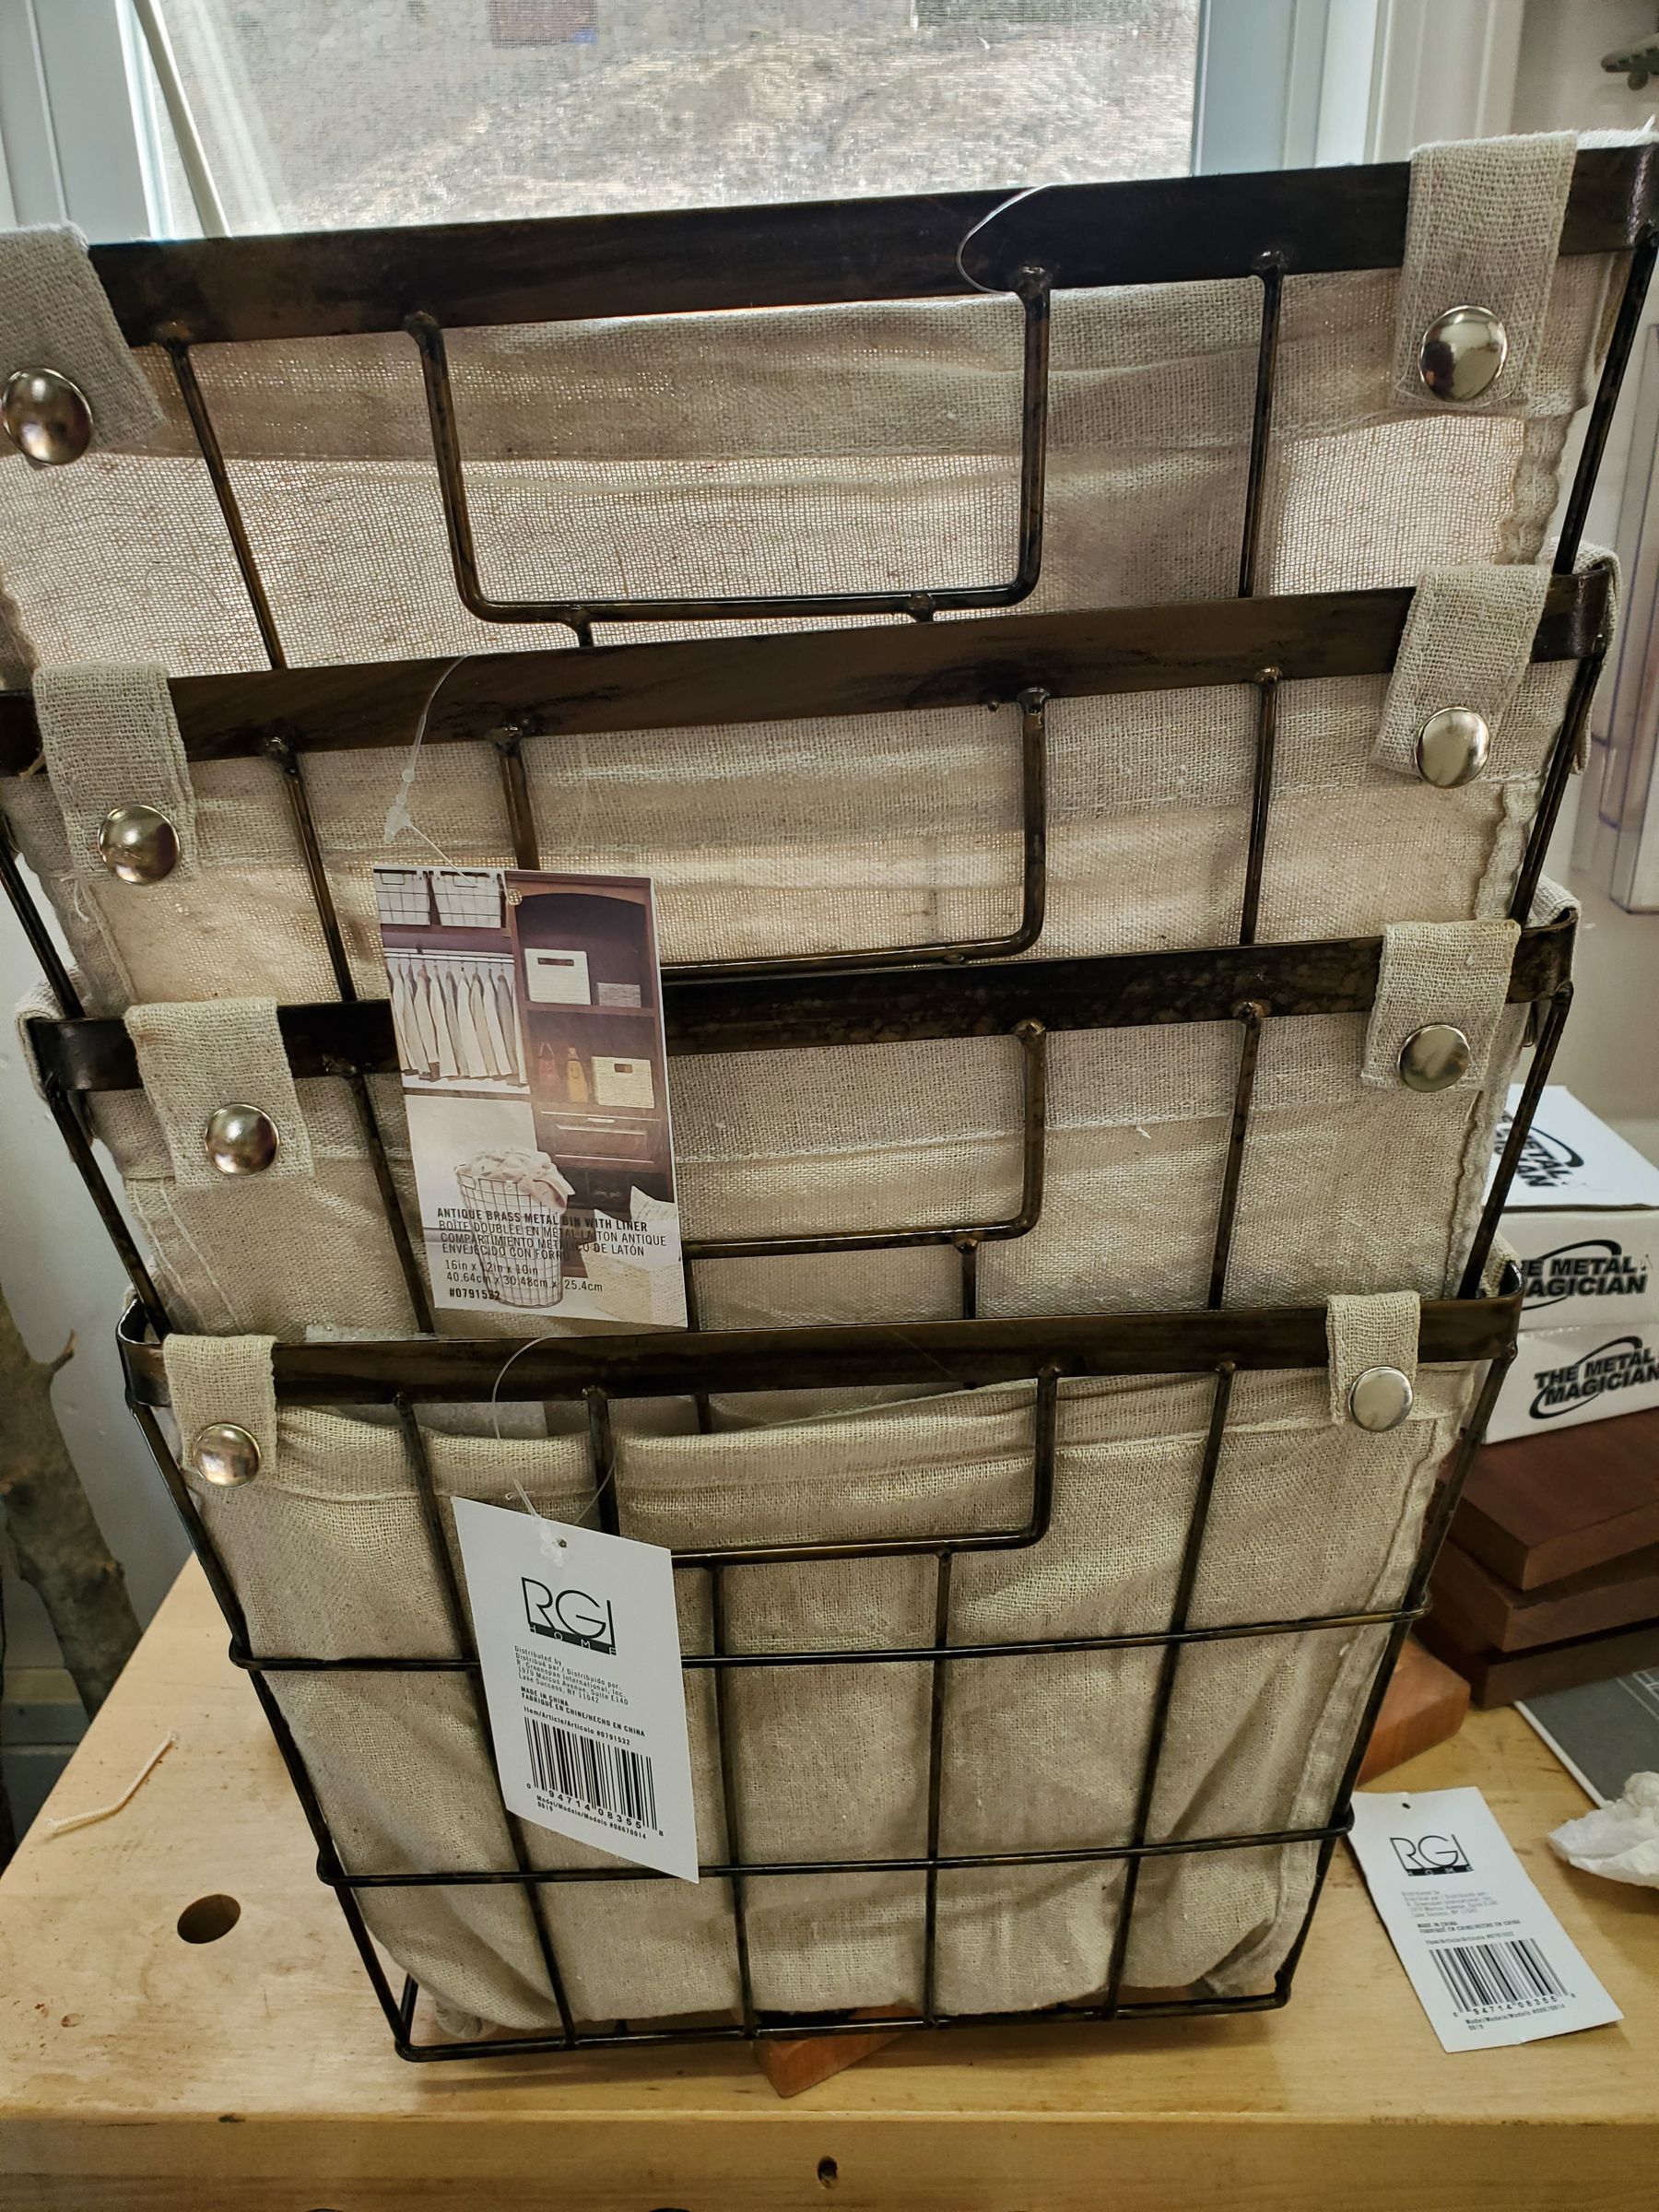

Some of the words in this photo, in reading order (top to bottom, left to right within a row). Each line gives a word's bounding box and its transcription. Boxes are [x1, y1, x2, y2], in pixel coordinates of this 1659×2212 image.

[437, 1207, 482, 1220] ANTIQUE
[488, 1211, 521, 1222] BRASS
[524, 1213, 559, 1225] METAL
[563, 1216, 581, 1227] BIN
[584, 1217, 611, 1230] WITH
[617, 1220, 648, 1232] LINER
[439, 1219, 469, 1231] BOÎTE
[474, 1222, 523, 1235] DOUBLÉE
[526, 1227, 539, 1236] EN
[621, 1233, 667, 1246] ANTIQUE
[441, 1232, 535, 1248] COMPARTIMIENTO
[594, 1242, 607, 1253] DE
[612, 1242, 644, 1256] LATÓN
[442, 1243, 506, 1256] ENVEJECIDO
[511, 1248, 531, 1258] CON
[535, 1250, 570, 1261] FORRO
[446, 1260, 468, 1270] 16in
[471, 1263, 477, 1271] x
[516, 1265, 538, 1276] 10in
[1549, 1255, 1638, 1277] METAL
[446, 1273, 491, 1284] 40.64cm
[503, 1276, 547, 1288] 30.48cm
[564, 1279, 603, 1292] 25.4cm
[1524, 1274, 1648, 1298] AGICIAN
[1534, 1364, 1581, 1389] THE
[1583, 1347, 1654, 1379] METAL
[521, 1577, 616, 1647] RGI
[514, 1645, 552, 1663] Distributed
[548, 1663, 560, 1672] par
[518, 1672, 535, 1684] Lake
[567, 1688, 577, 1696] NY
[579, 1690, 600, 1704] 11042
[525, 1662, 561, 1679] Greenspan
[612, 1689, 627, 1699] Inc.
[535, 1671, 560, 1685] Marcus
[591, 1689, 609, 1700] Suite
[611, 1694, 629, 1705] E140
[521, 1686, 539, 1698] MADE
[548, 1696, 570, 1707] CHINA
[555, 1703, 565, 1712] EN
[612, 1722, 622, 1731] EN
[624, 1724, 645, 1736] CHINA
[548, 1790, 592, 1811] 94714
[598, 1808, 642, 1829] 08355
[1390, 1834, 1470, 1870] RGI
